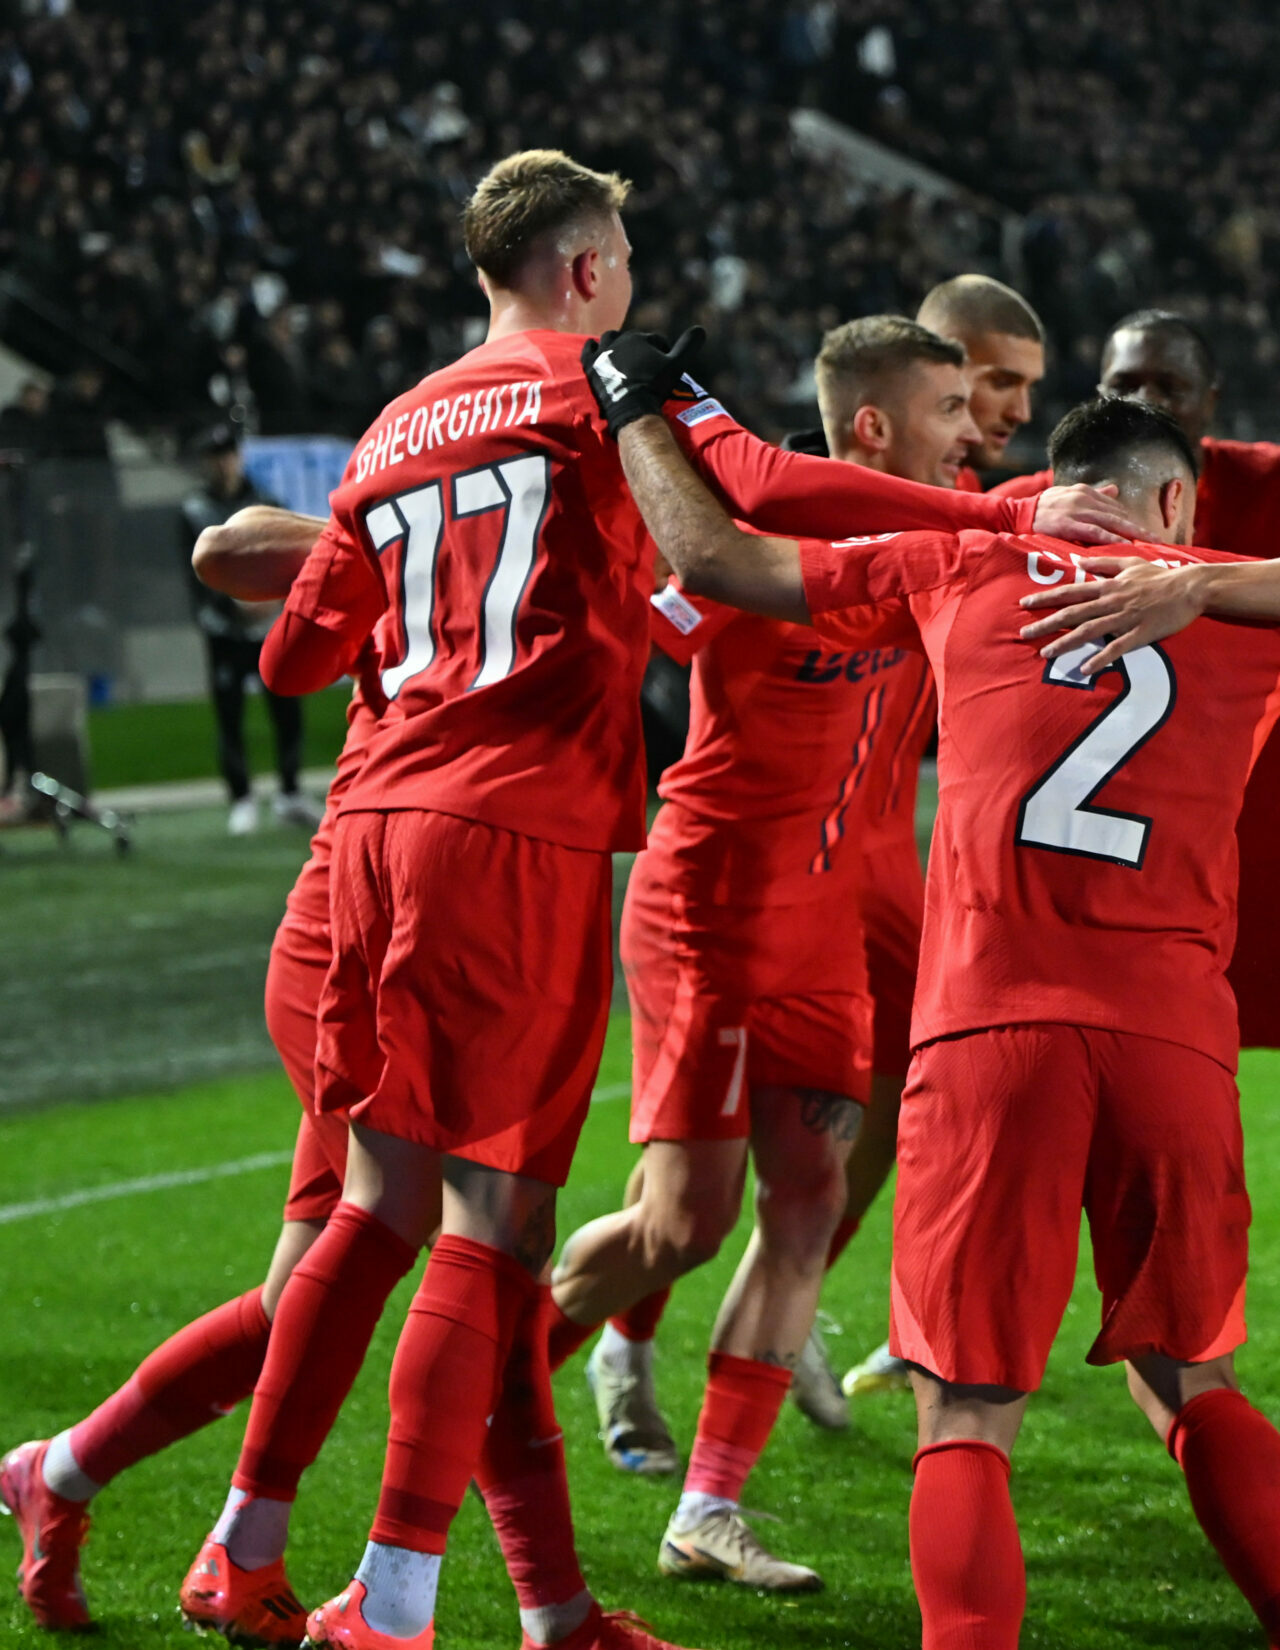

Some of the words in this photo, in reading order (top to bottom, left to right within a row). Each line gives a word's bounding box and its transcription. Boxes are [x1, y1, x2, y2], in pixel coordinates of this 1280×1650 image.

[355, 380, 544, 483] GHEORGHITA
[364, 449, 552, 701] 77
[1014, 633, 1178, 871] 2
[718, 1026, 747, 1116] 7
